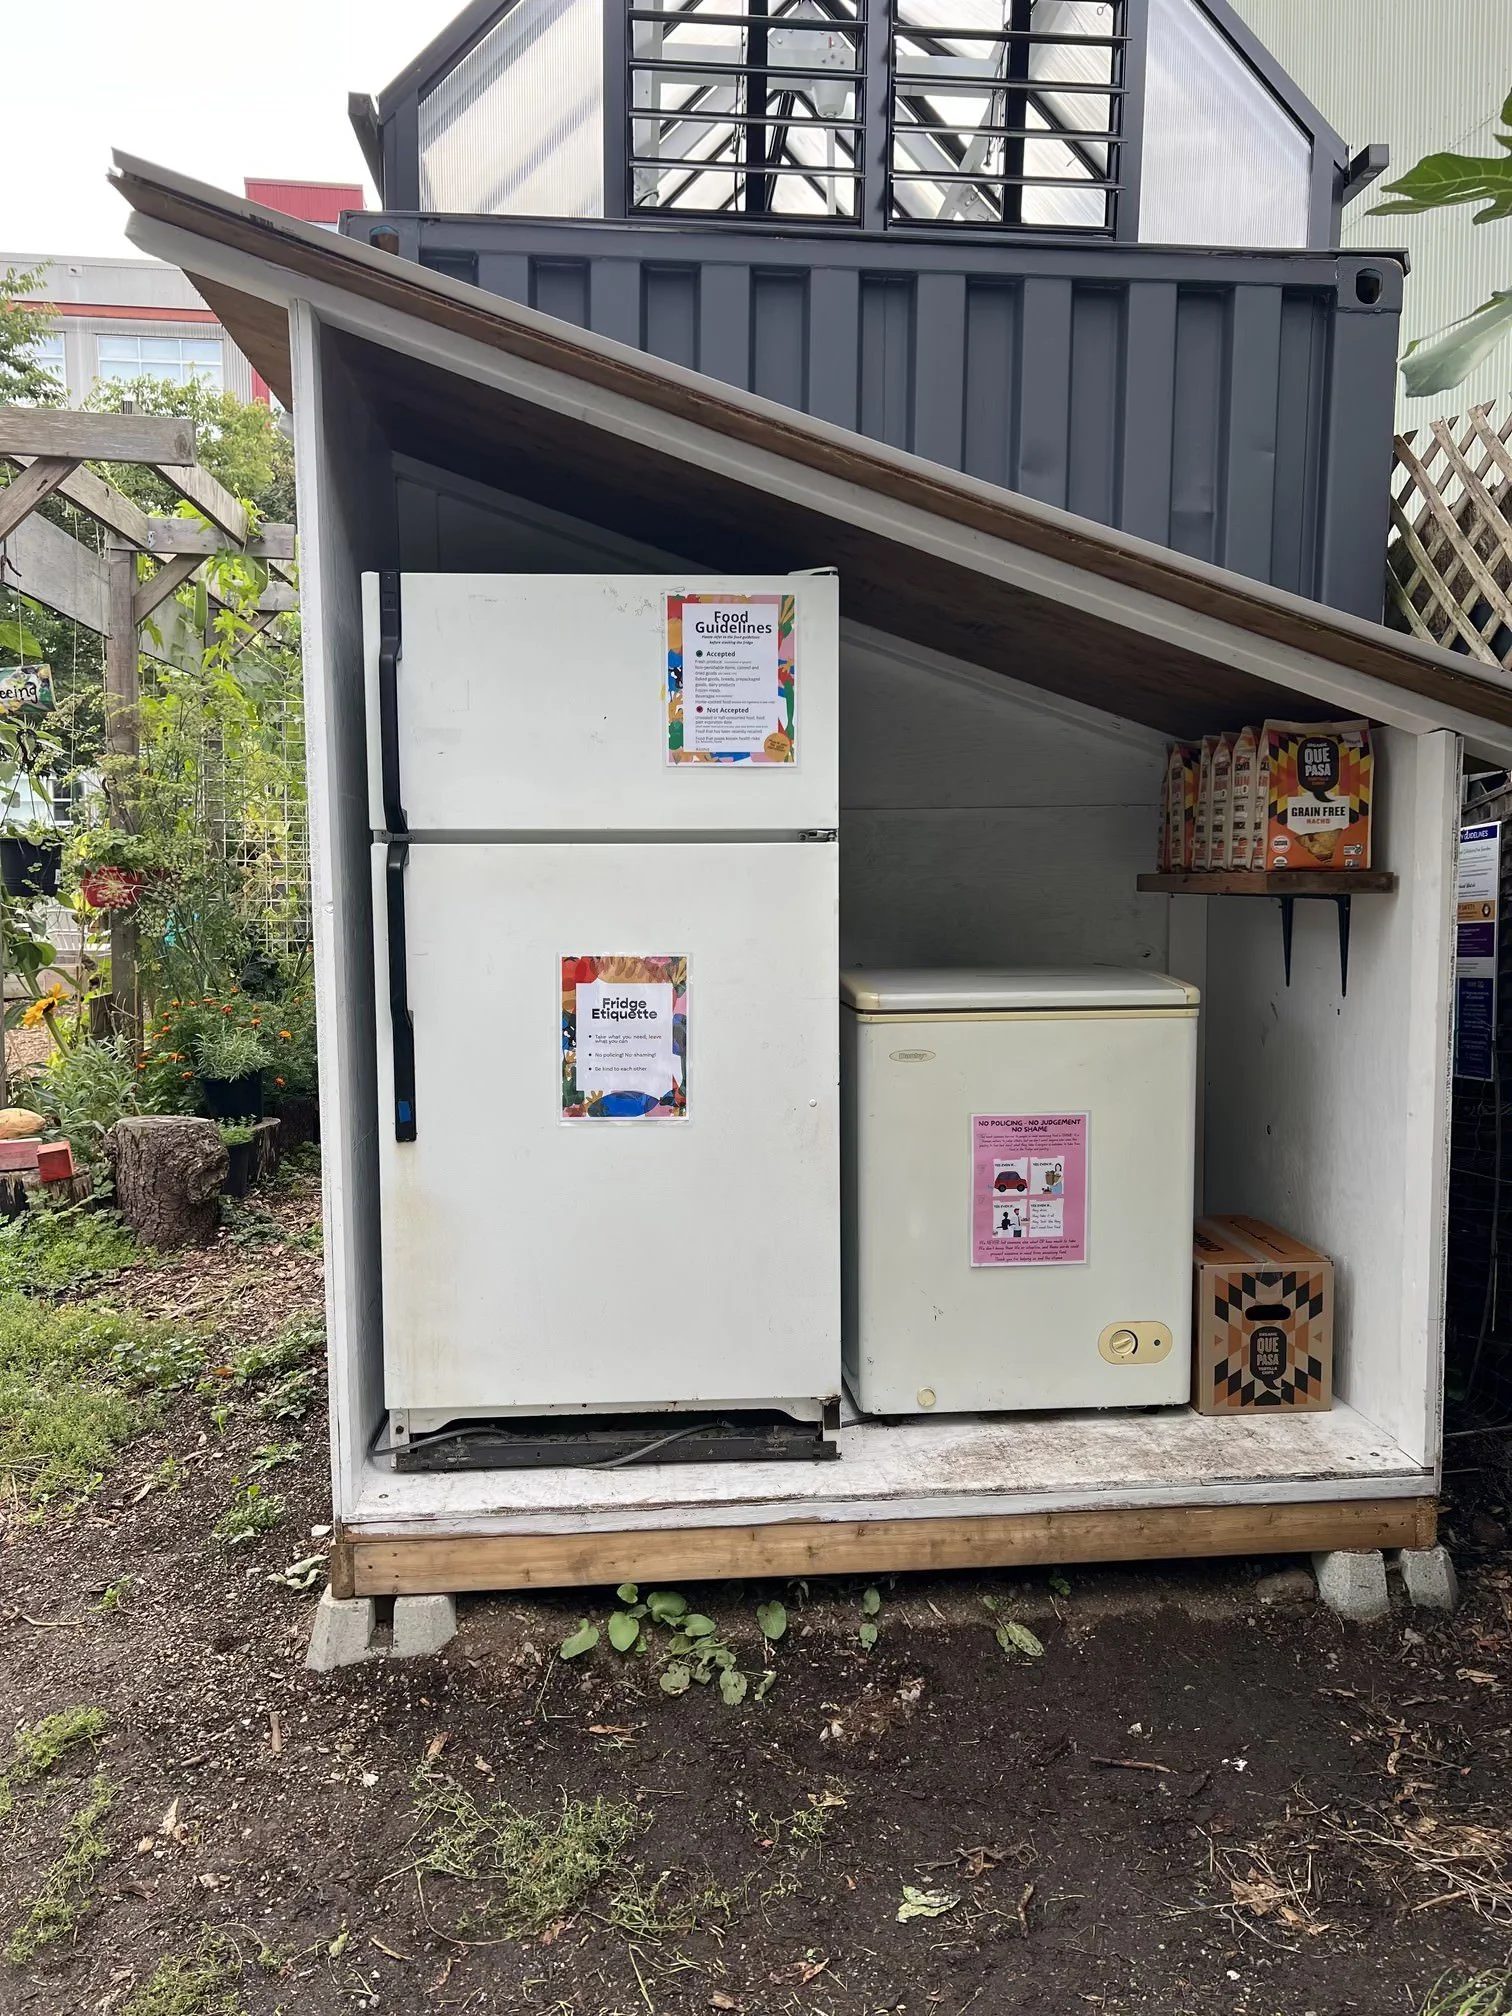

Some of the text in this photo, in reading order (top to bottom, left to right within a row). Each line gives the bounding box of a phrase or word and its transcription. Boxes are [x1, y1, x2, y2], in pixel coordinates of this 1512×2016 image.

[714, 611, 749, 623] Food
[695, 621, 772, 634] Guidelines
[1304, 747, 1331, 764] QUE
[1305, 763, 1331, 776] PASA
[1291, 806, 1346, 817] GRAIN FREE
[602, 997, 647, 1011] Fridge
[591, 1008, 658, 1022] Etiquette
[1256, 1337, 1279, 1354] QUE
[1256, 1354, 1279, 1366] PASA
